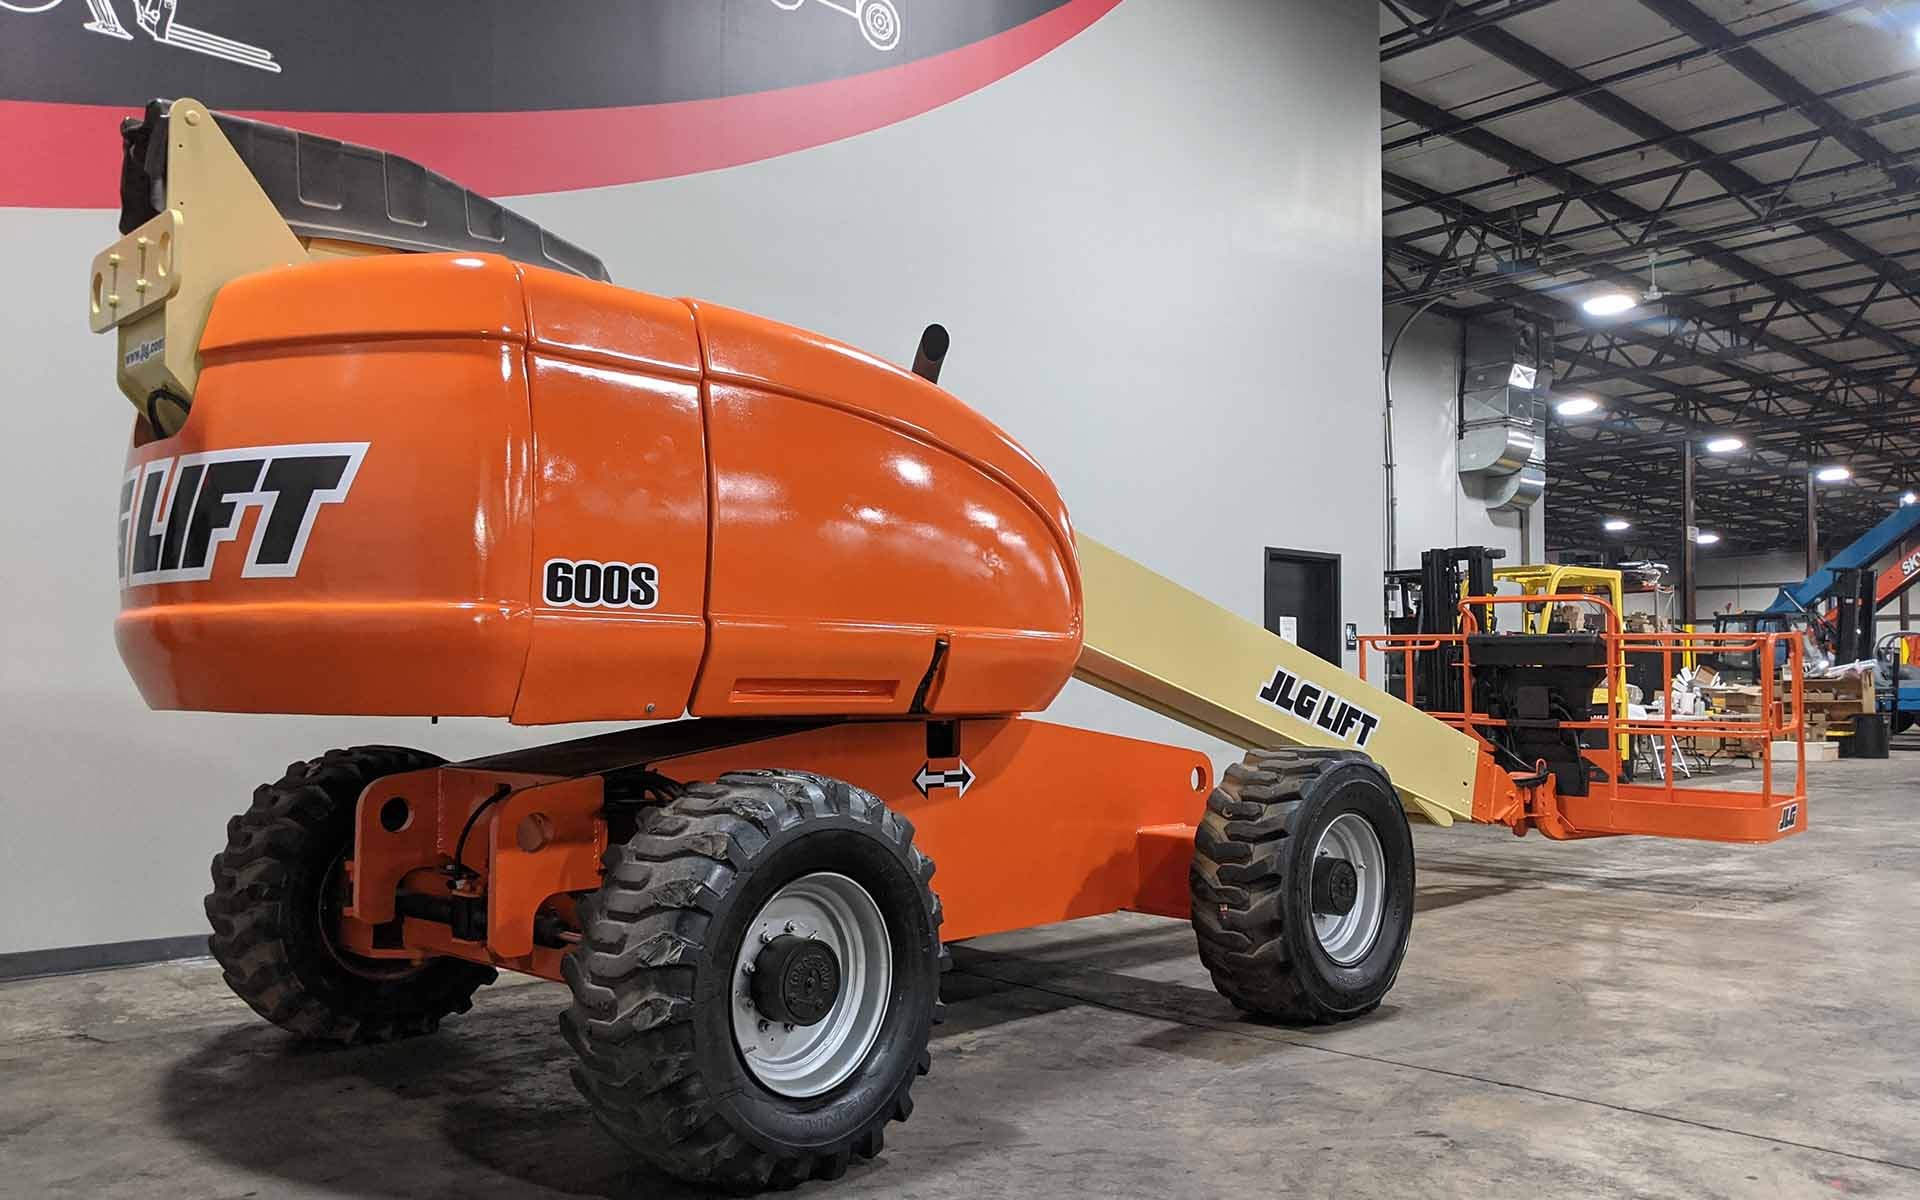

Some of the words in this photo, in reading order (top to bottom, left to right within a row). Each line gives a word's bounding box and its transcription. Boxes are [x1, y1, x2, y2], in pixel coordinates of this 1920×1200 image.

[131, 449, 361, 579] LIFT
[546, 560, 657, 607] 600S
[1259, 670, 1321, 719] JLG
[1316, 696, 1378, 747] LIFT
[1779, 805, 1797, 830] JLG
